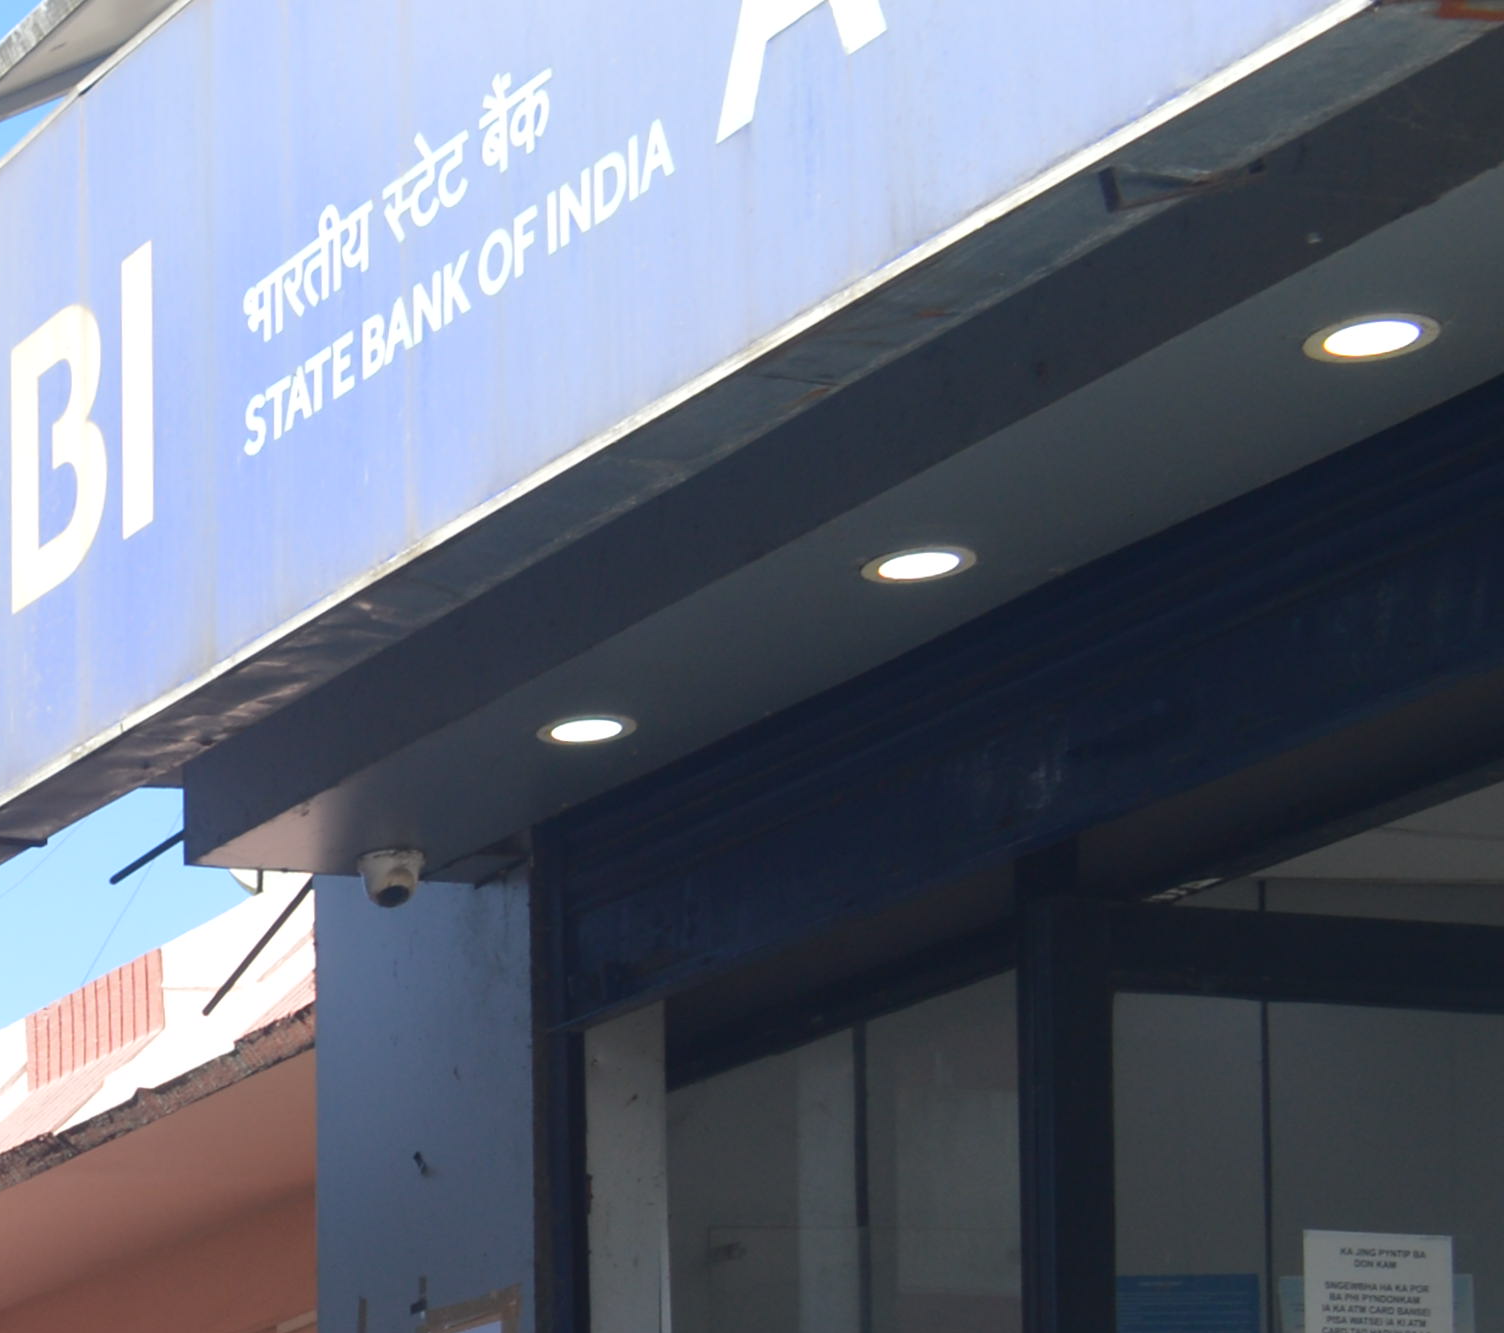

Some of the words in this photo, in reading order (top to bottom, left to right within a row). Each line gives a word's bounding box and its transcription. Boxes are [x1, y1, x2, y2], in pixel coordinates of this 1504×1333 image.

[243, 199, 373, 341] भारतीय
[382, 131, 469, 243] स्टेट
[478, 68, 552, 173] बैंक
[243, 330, 354, 456] STATE
[362, 250, 471, 381] BANK
[478, 204, 538, 296] OF
[547, 118, 675, 255] INDIA
